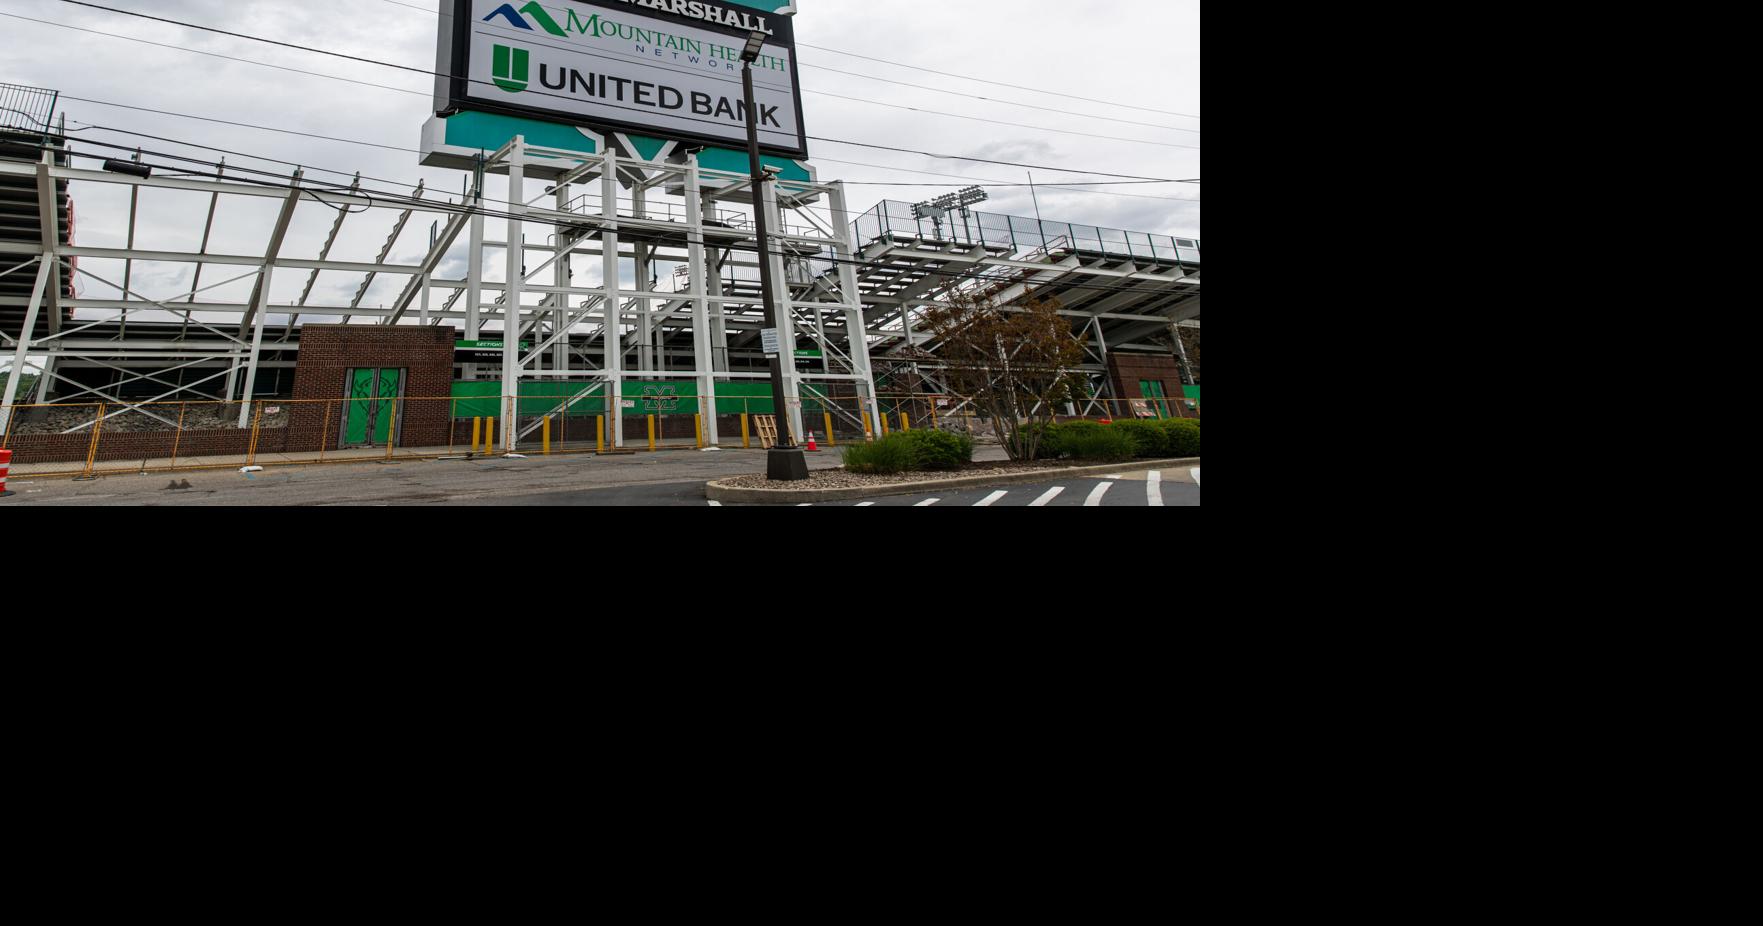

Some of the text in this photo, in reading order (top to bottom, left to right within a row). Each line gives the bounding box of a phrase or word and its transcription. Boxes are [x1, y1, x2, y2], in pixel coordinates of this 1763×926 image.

[621, 0, 773, 35] ARSHALL
[635, 44, 735, 71] NETWOR
[709, 43, 786, 72] HETH
[539, 63, 781, 128] UNITED BANK
